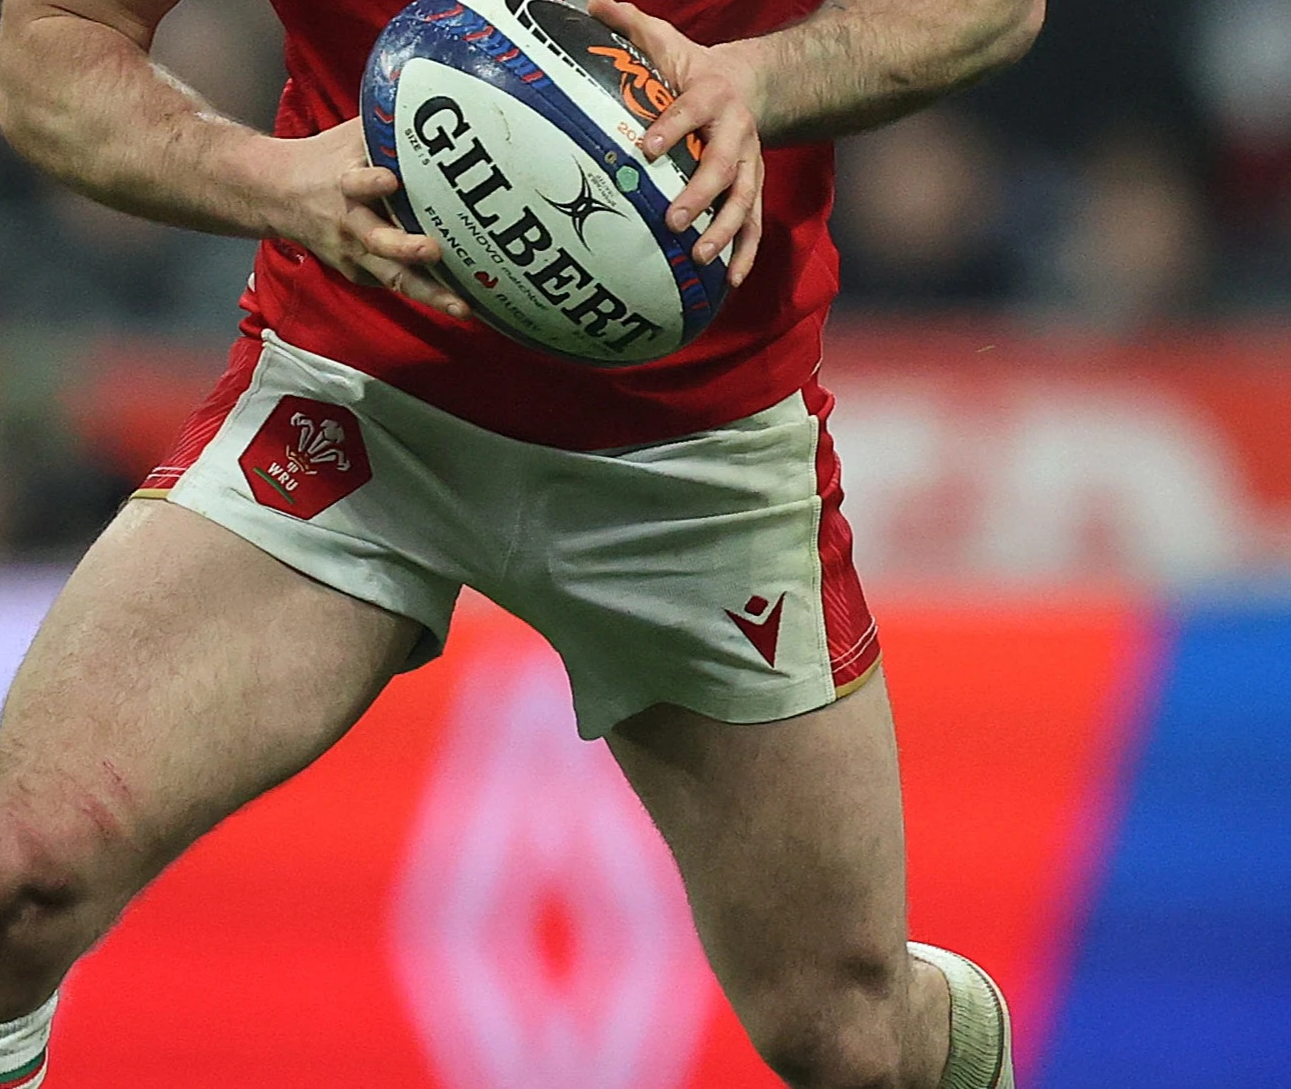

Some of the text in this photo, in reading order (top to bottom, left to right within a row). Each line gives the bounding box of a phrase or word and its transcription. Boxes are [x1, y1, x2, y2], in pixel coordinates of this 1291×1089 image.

[404, 128, 422, 152] SIZE
[413, 95, 663, 353] GILBERT
[424, 206, 477, 267] FRANCE
[268, 462, 299, 491] WRU
